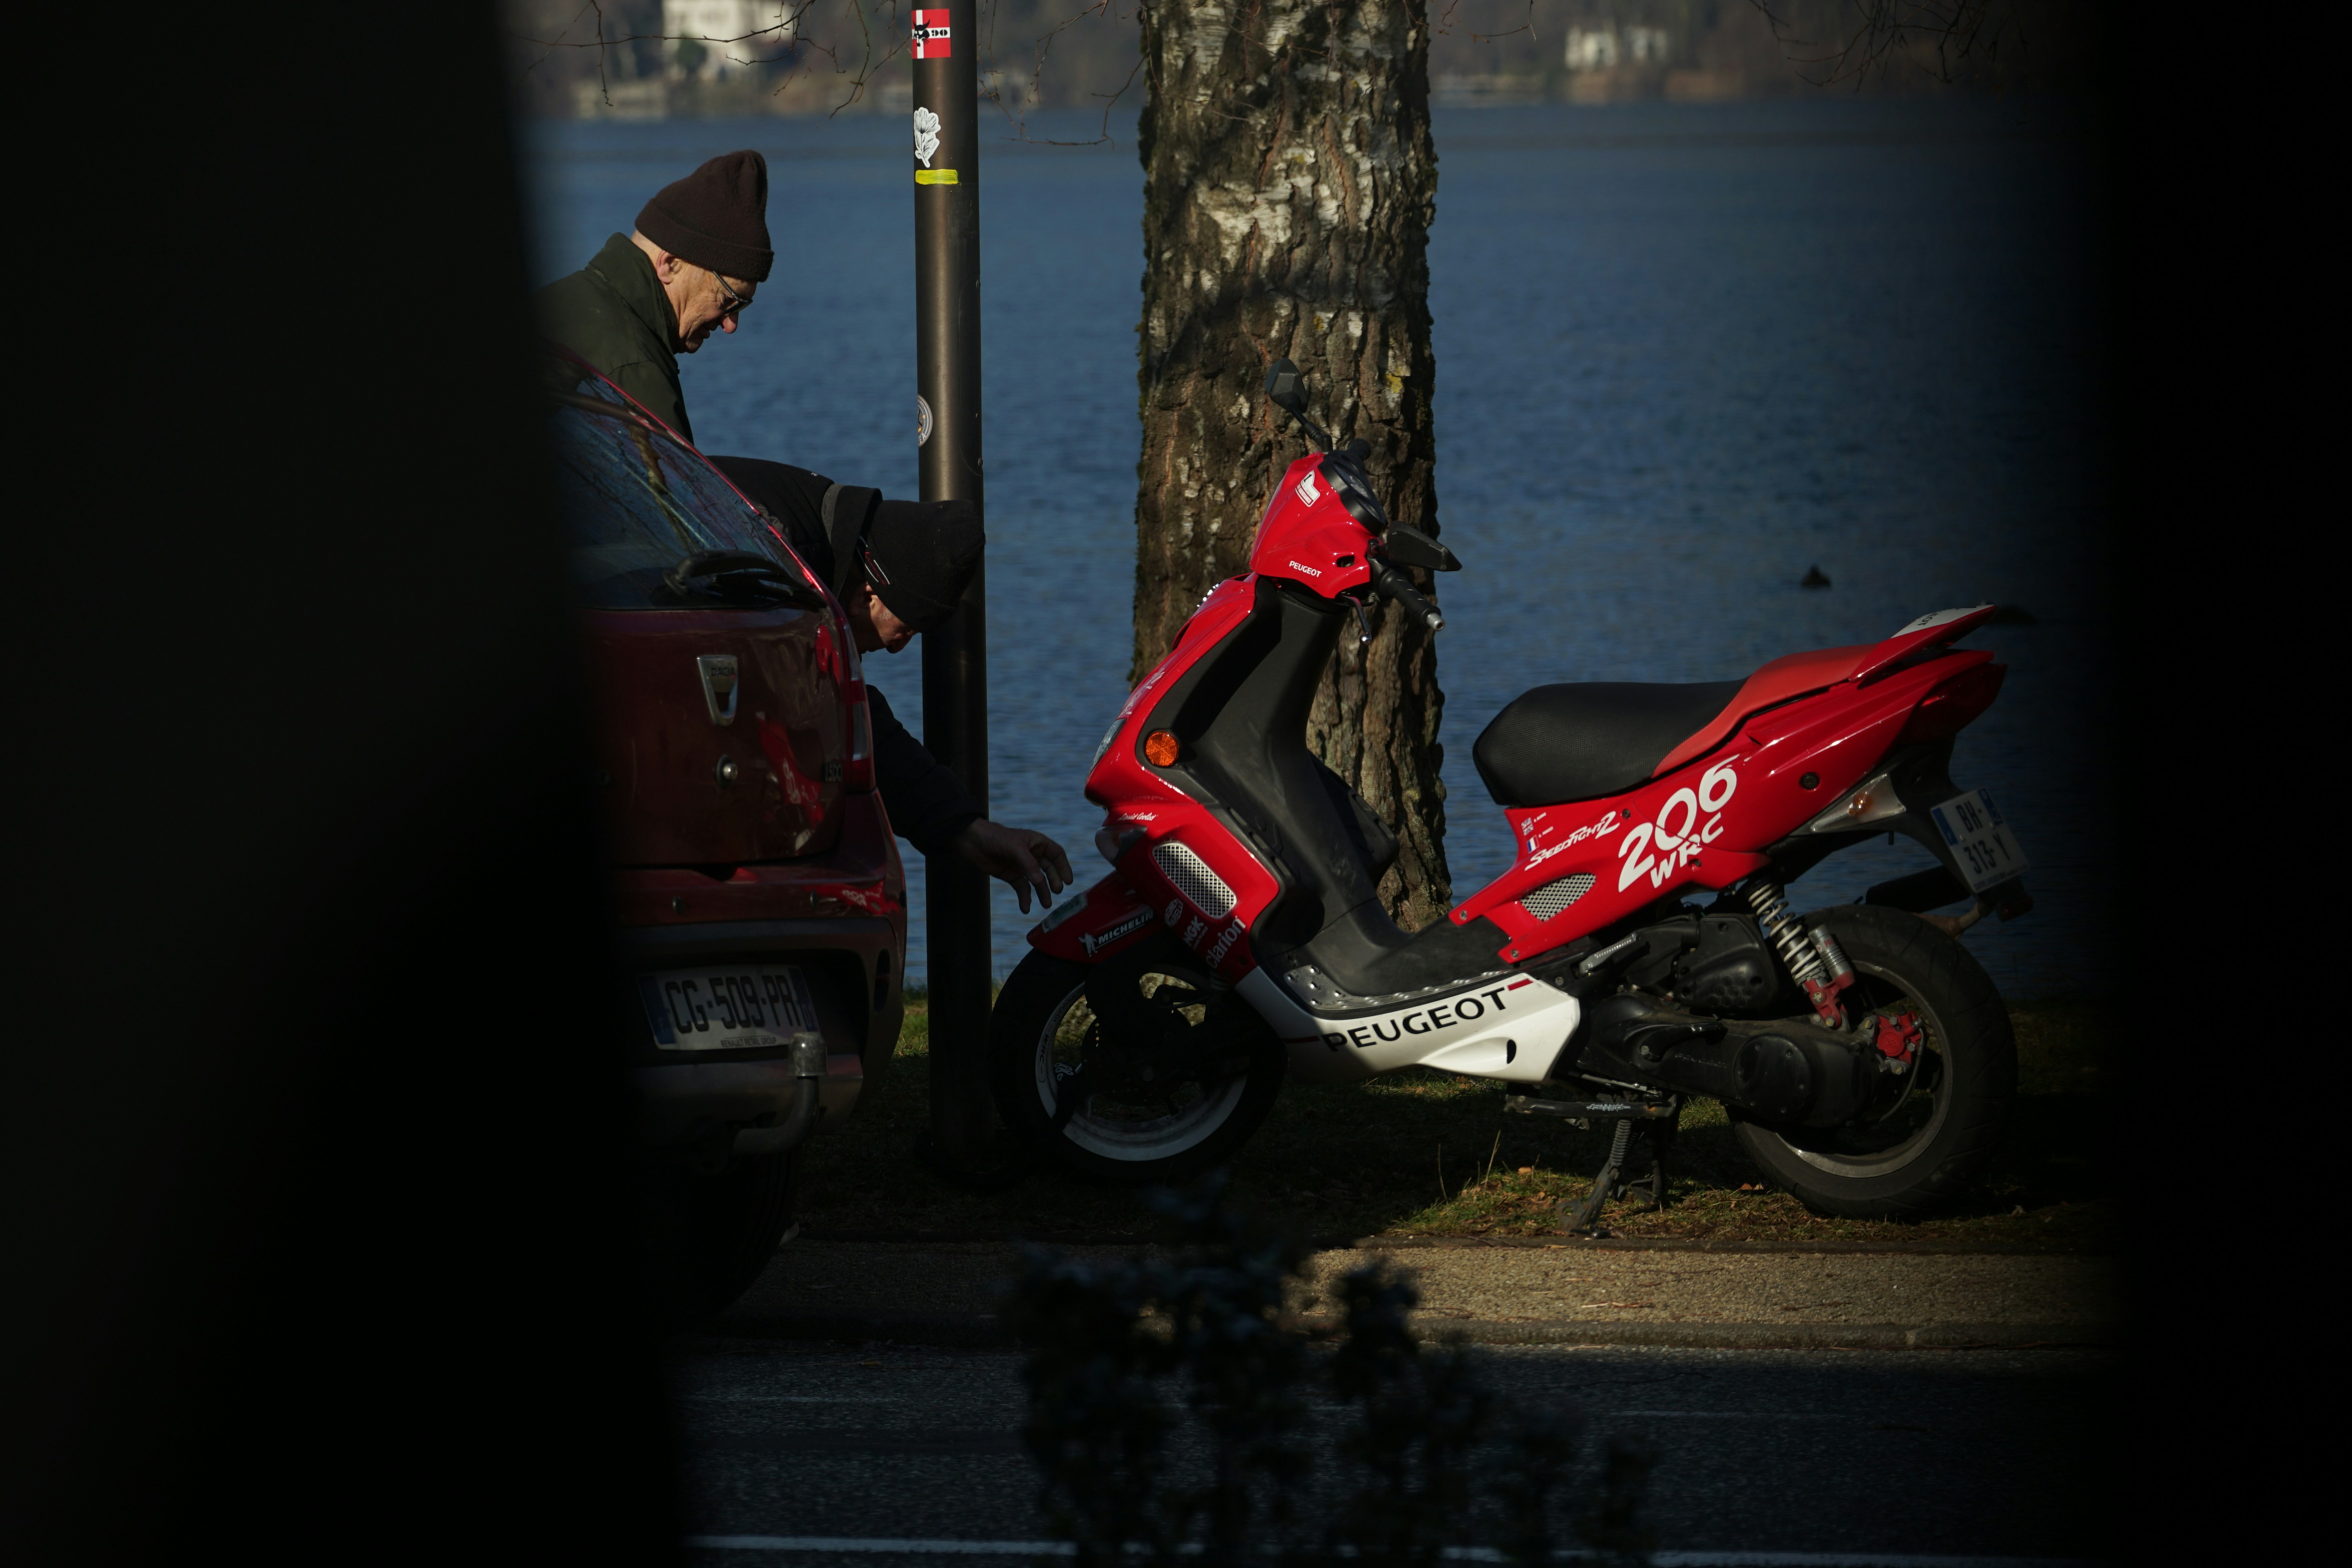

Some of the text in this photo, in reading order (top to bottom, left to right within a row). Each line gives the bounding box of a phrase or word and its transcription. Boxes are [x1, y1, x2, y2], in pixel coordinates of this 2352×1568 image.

[1289, 560, 1322, 577] PEUGEOT
[711, 667, 735, 677] DACIA
[1618, 753, 1740, 893] 206
[1650, 811, 1724, 889] WRC
[1098, 910, 1154, 945] MICHELIN
[1183, 915, 1205, 947] NGK
[1205, 918, 1247, 968] clarion
[1321, 987, 1506, 1052] PEUGEOT
[720, 1038, 744, 1047] RENAULT
[1040, 1033, 1049, 1063] WRC
